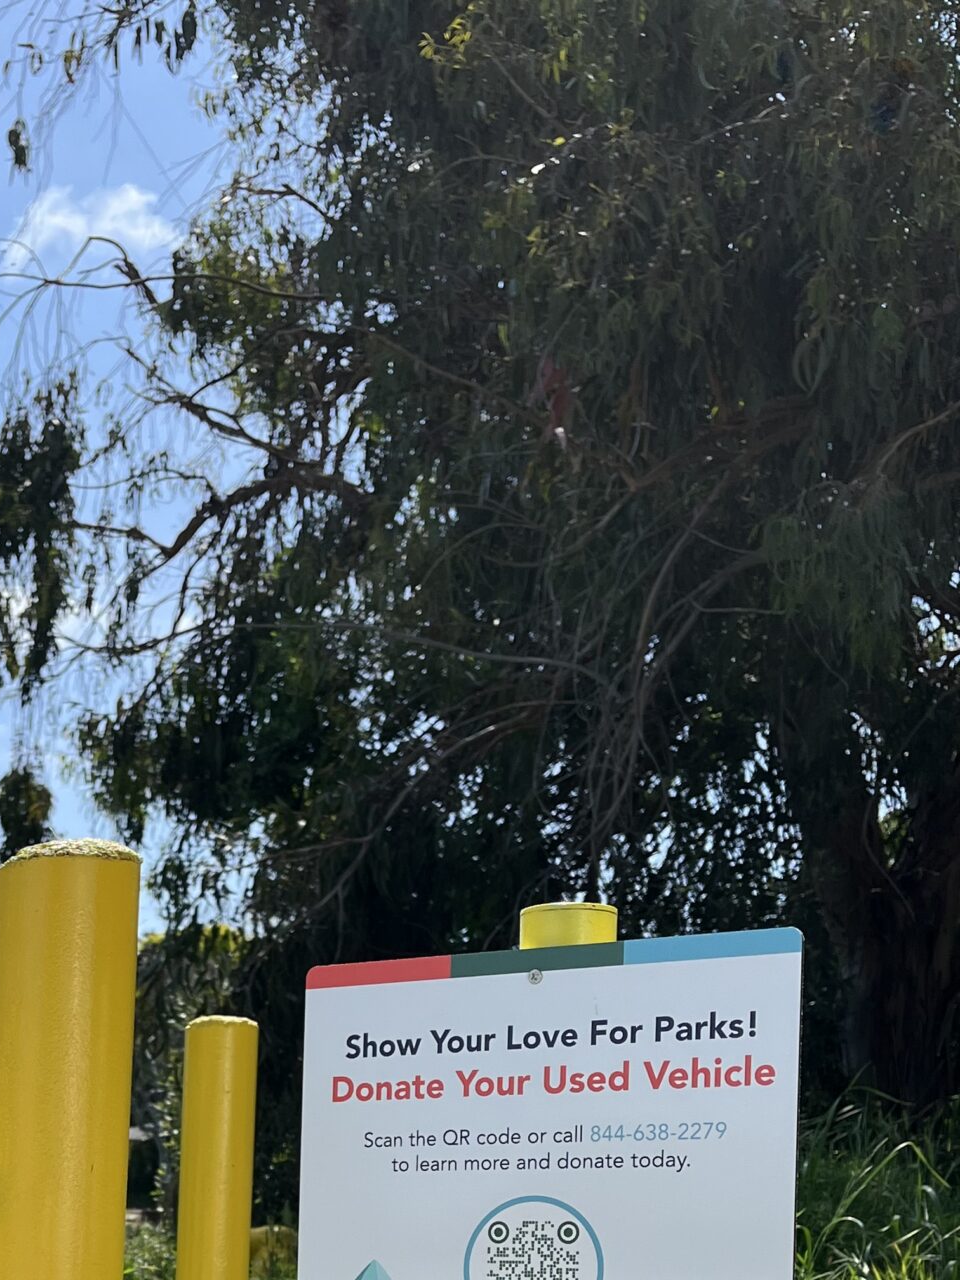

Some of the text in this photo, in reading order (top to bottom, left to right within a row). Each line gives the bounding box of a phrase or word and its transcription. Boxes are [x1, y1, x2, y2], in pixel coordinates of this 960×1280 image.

[345, 1010, 756, 1059] Show Your Love For Parks!
[331, 1054, 775, 1102] Donate Your Used Vehicle
[363, 1121, 726, 1148] Scan the QR code or call 844-638-2279
[391, 1150, 690, 1172] to learn more and donate today.
